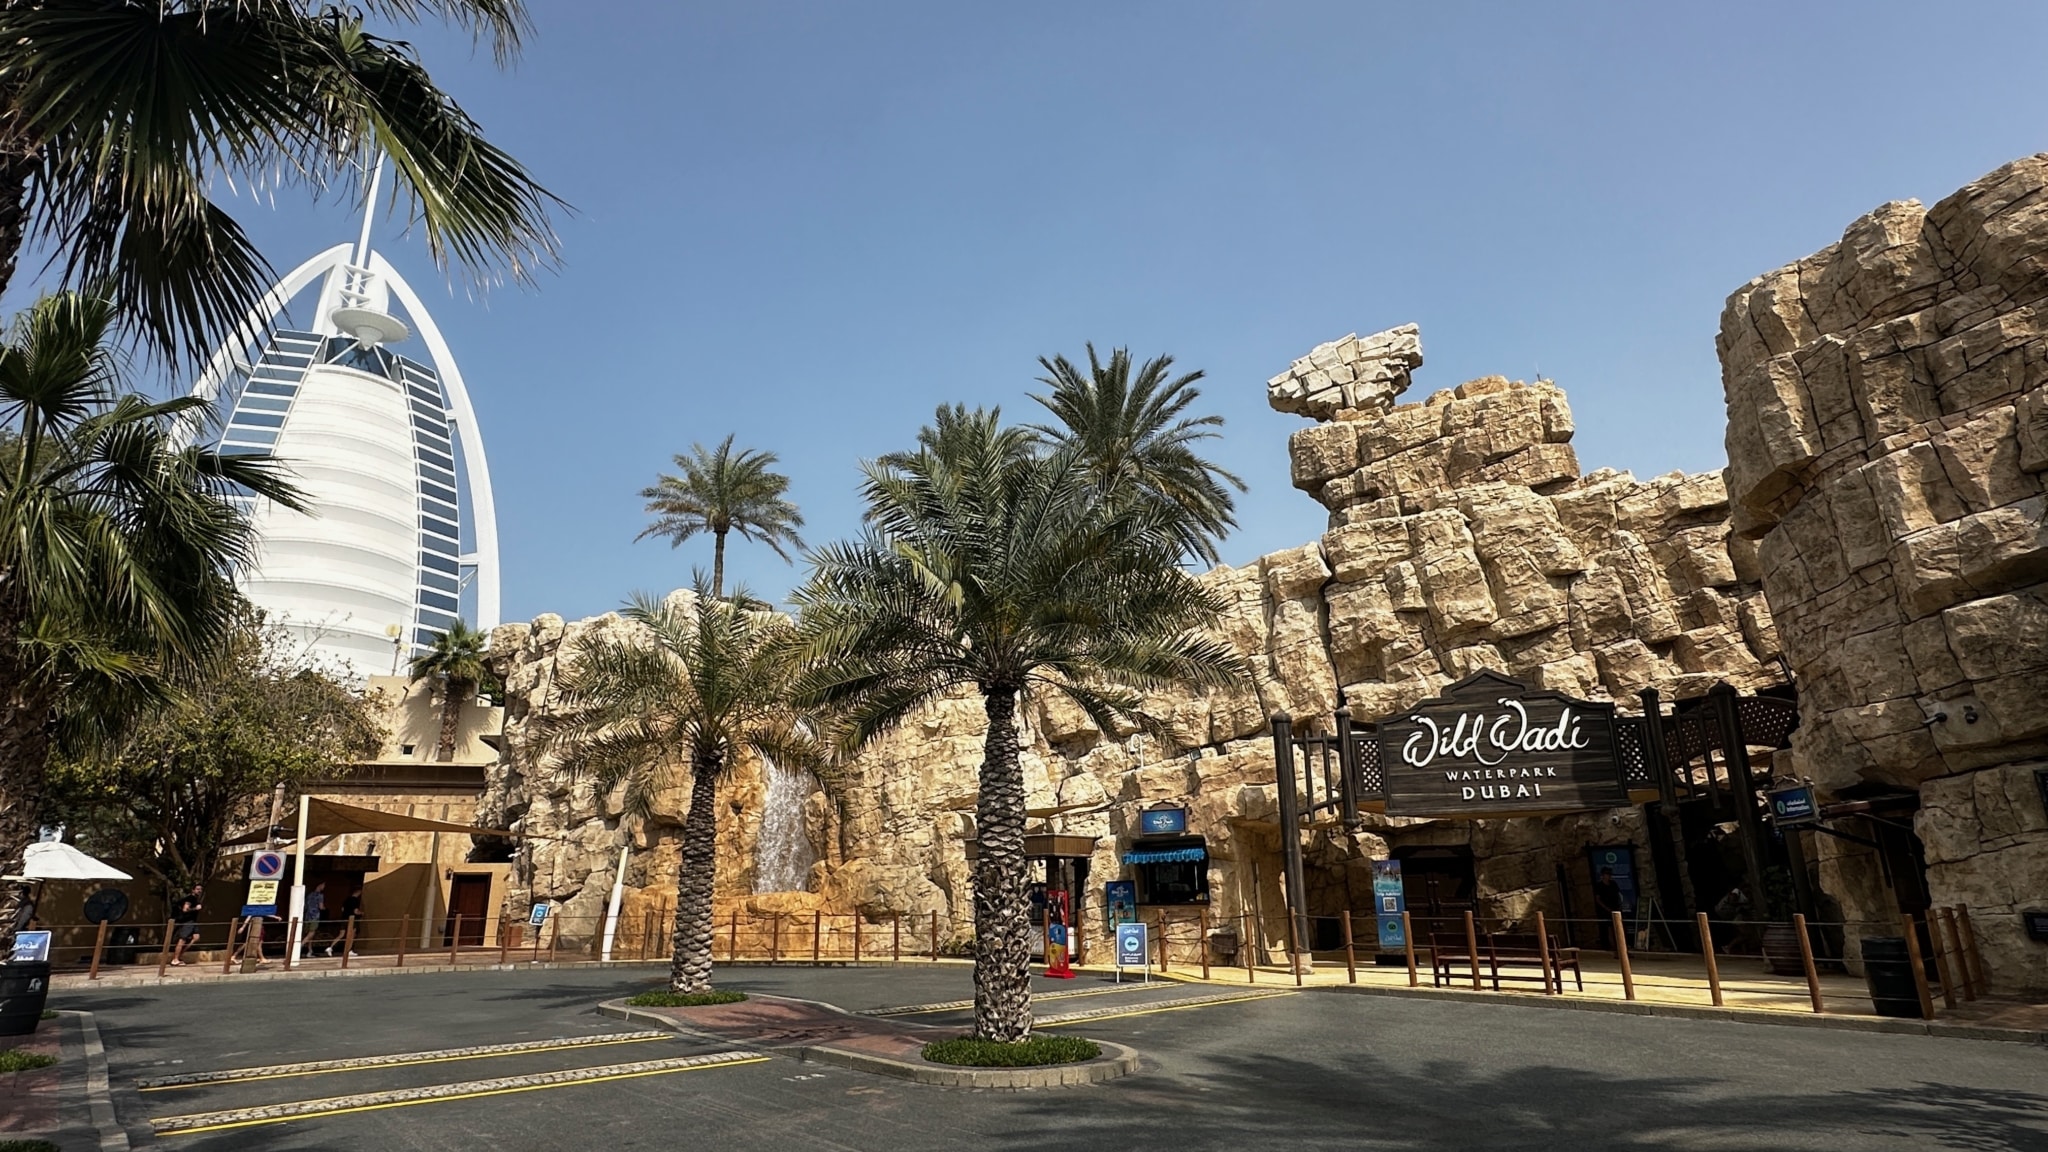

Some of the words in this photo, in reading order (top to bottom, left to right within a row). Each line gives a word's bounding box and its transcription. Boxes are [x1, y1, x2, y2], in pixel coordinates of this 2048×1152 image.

[1403, 713, 1508, 767] Wild
[1490, 698, 1590, 751] Wadi
[1446, 766, 1557, 782] WATERPARK
[1462, 783, 1542, 800] DUBAI
